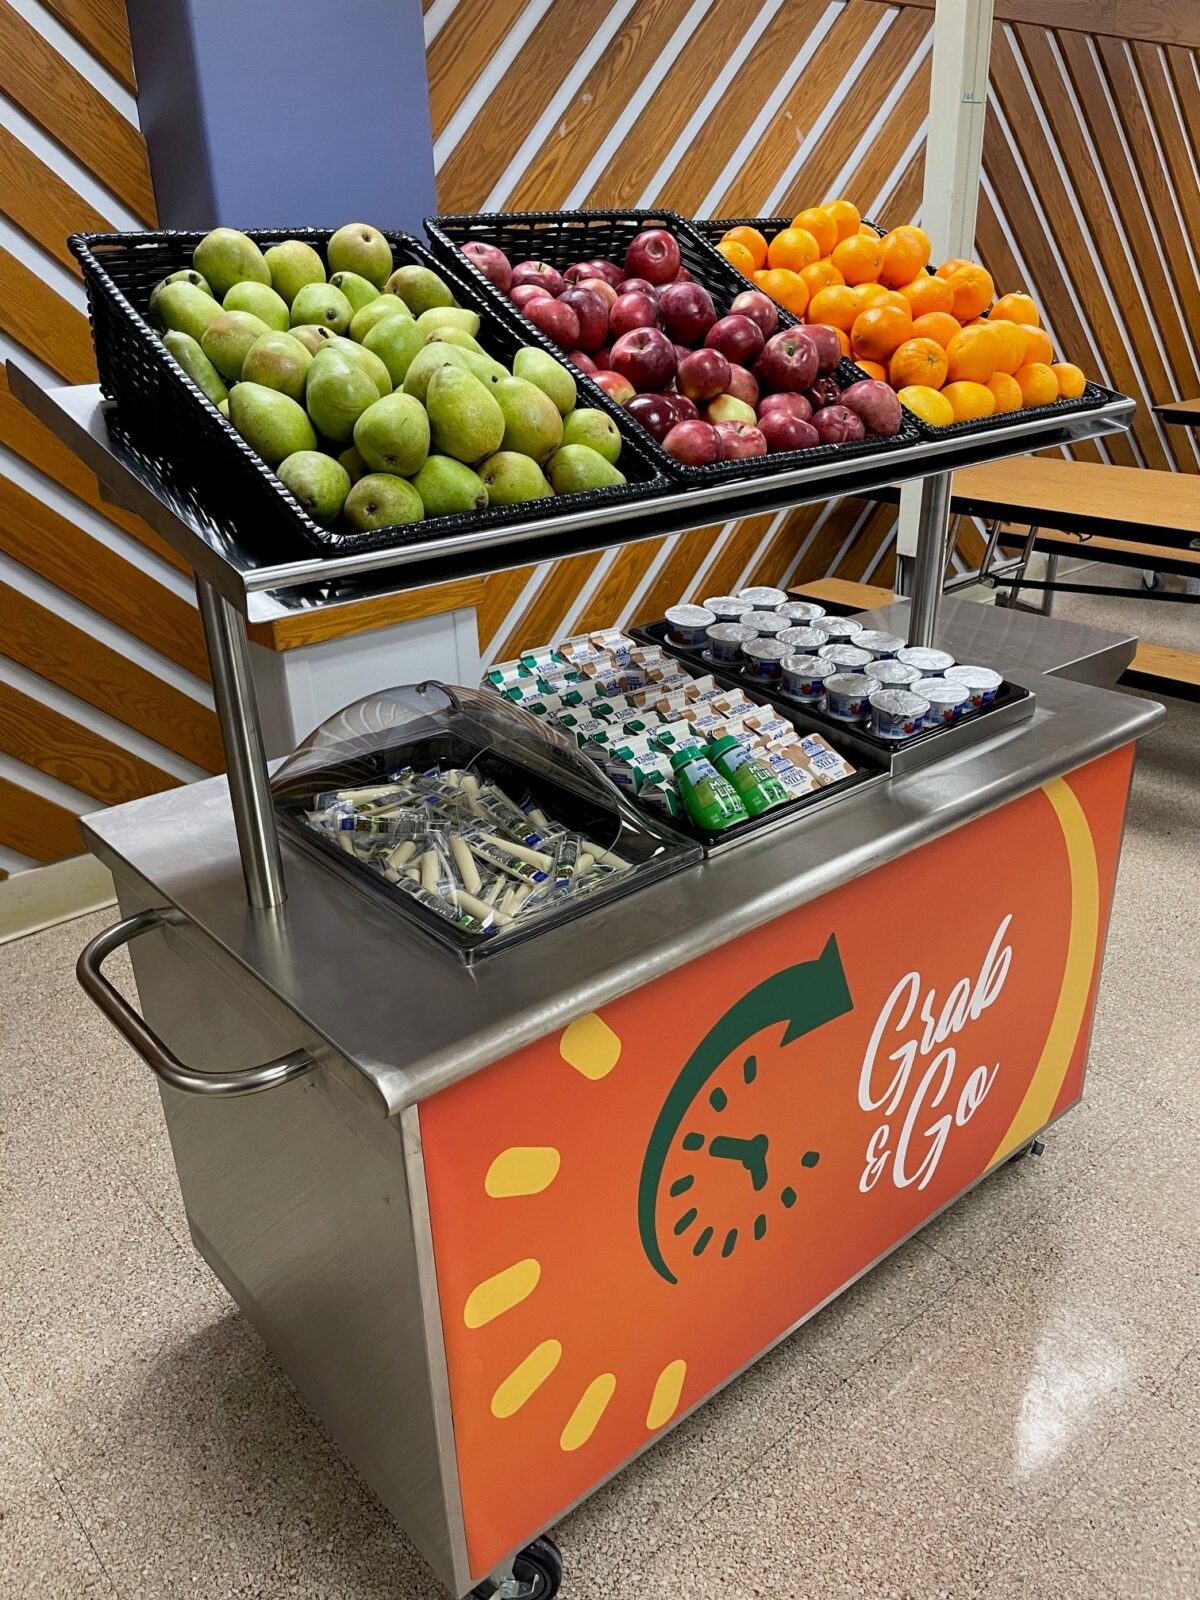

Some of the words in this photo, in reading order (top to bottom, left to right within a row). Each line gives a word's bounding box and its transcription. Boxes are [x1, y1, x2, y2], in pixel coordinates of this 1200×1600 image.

[784, 775, 807, 787] MILK
[816, 757, 840, 769] MILK
[858, 914, 1013, 1116] Grab
[859, 1124, 892, 1193] &
[893, 1047, 1000, 1190] Go
